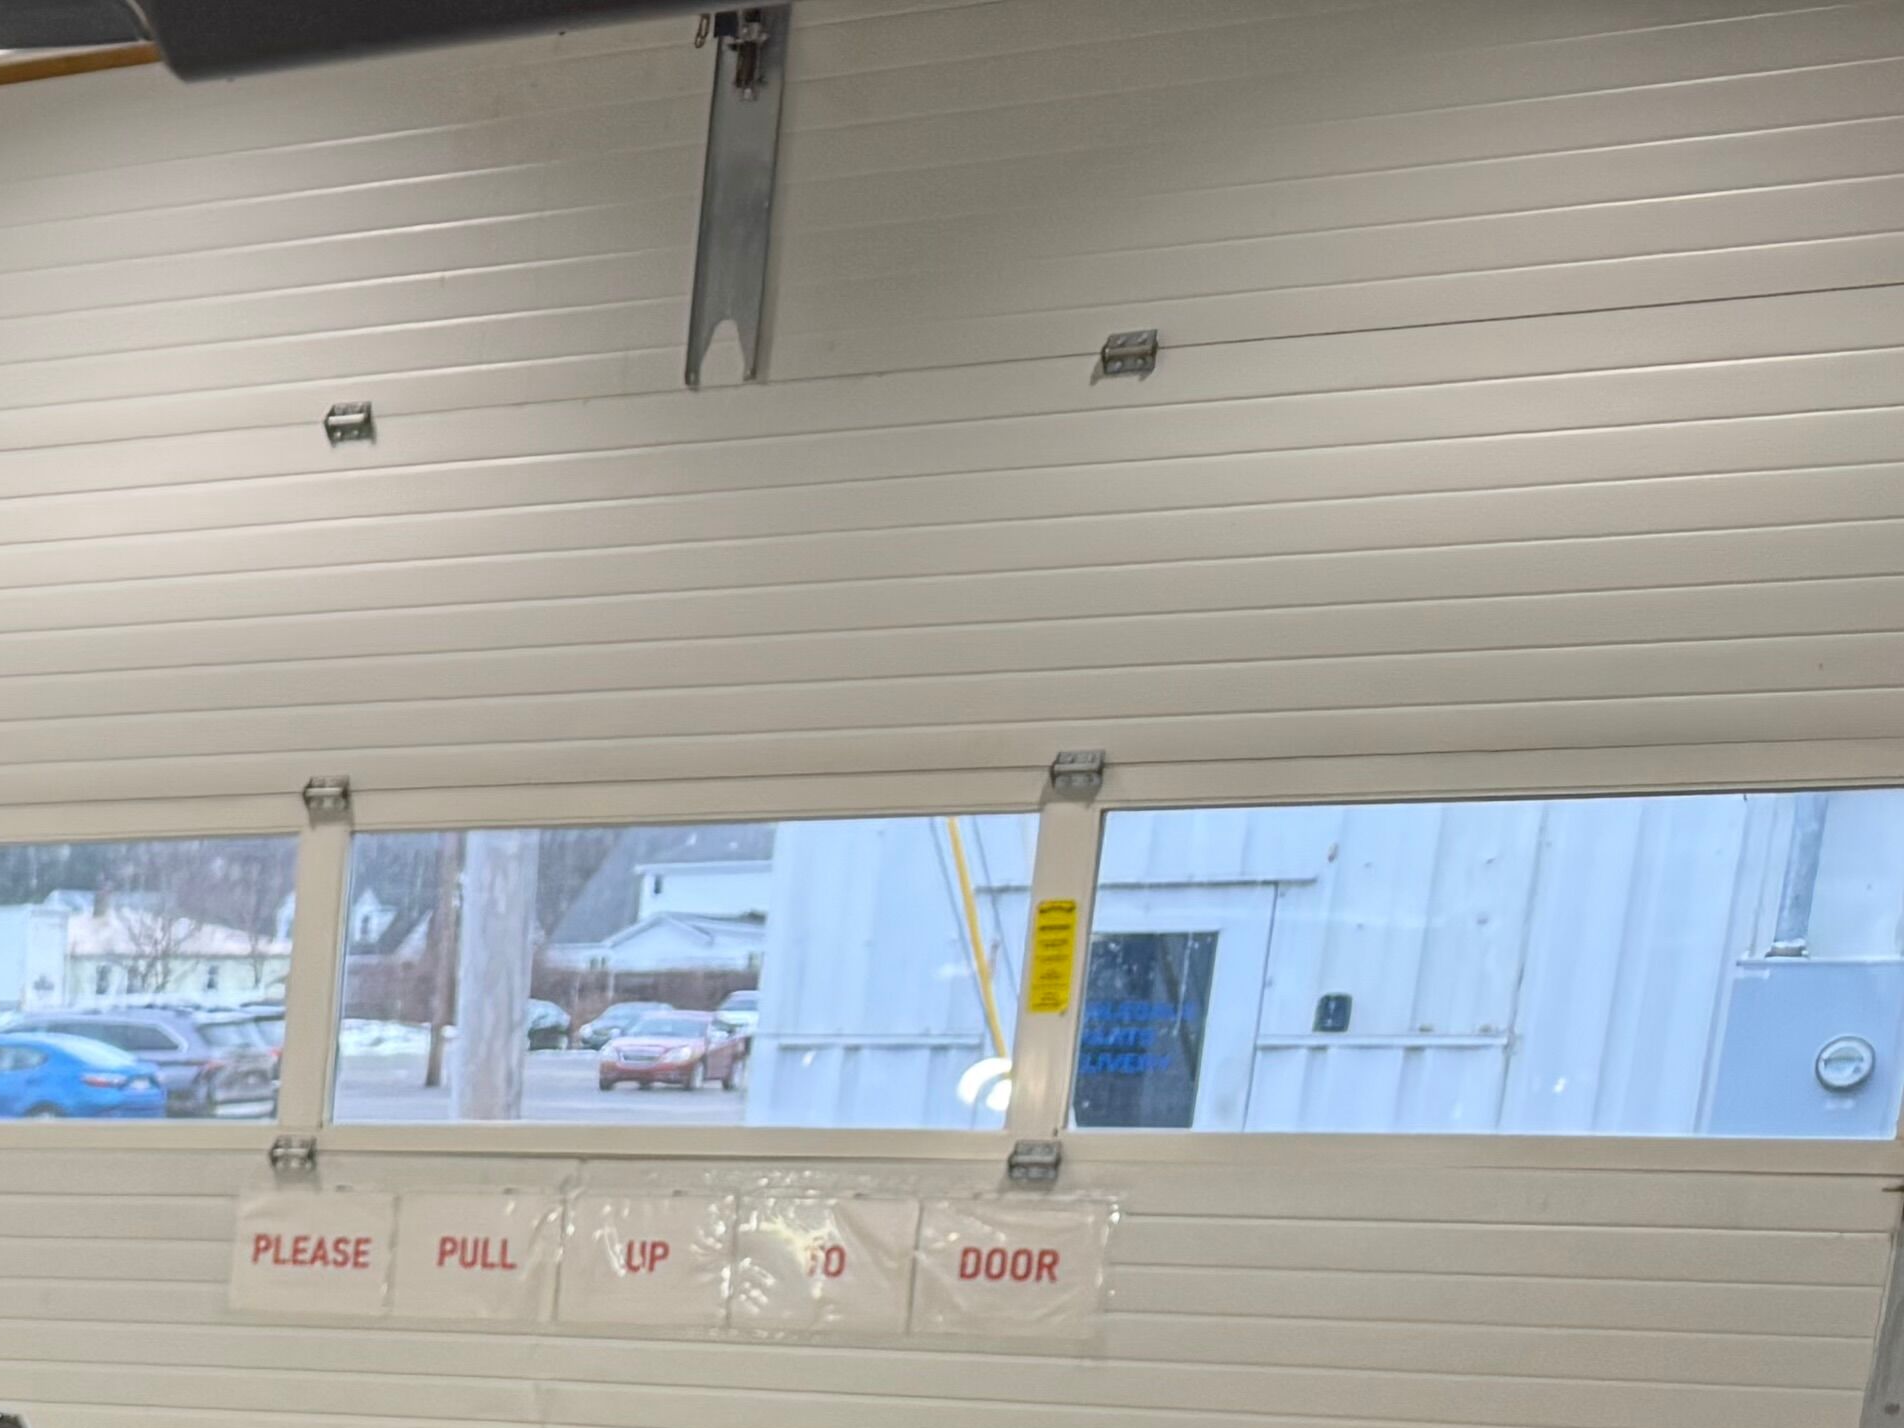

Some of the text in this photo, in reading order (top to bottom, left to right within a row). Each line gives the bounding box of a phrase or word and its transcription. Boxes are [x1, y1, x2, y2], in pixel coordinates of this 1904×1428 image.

[252, 1233, 372, 1270] PLEASE
[436, 1235, 518, 1270] PULL
[625, 1239, 670, 1273] UP
[959, 1246, 1060, 1283] DOOR
